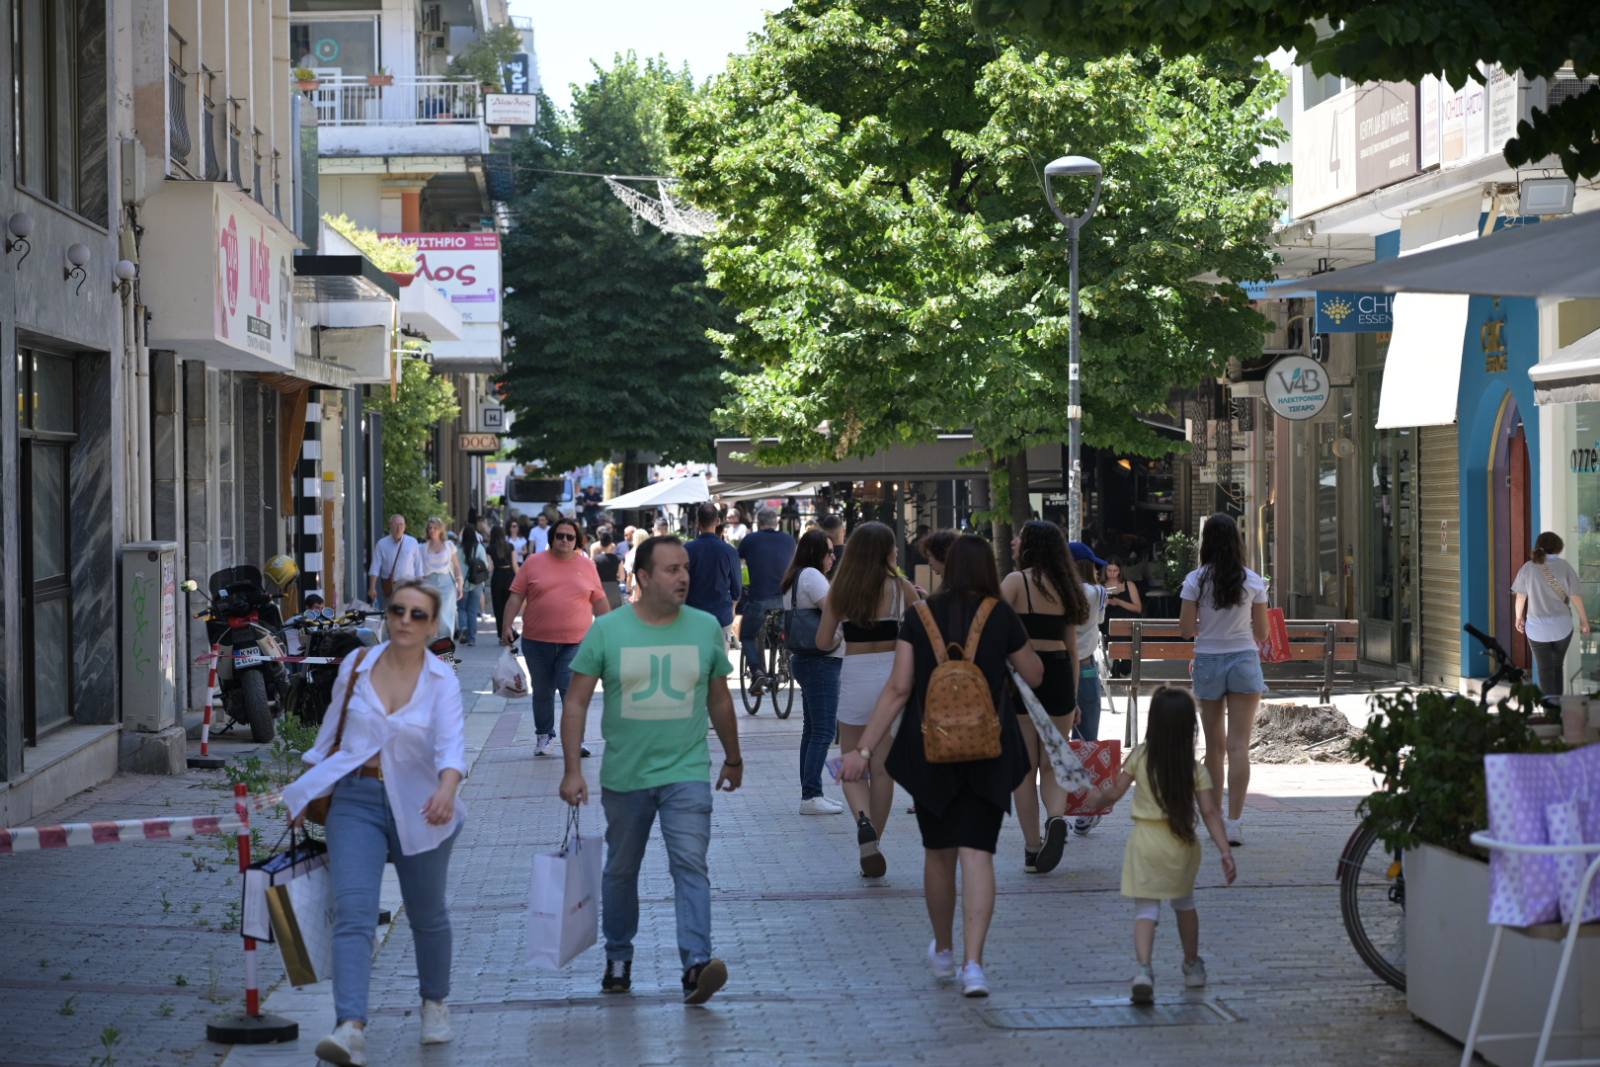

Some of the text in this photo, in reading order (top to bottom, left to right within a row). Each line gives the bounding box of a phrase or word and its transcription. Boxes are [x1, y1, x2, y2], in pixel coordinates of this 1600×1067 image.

[399, 236, 467, 249] ΝΤΙΣΤΗΡΙΟ
[416, 253, 477, 287] λος
[1358, 296, 1393, 313] CHI
[1358, 314, 1393, 325] ESSEN
[1276, 368, 1321, 394] V4B
[461, 436, 498, 449] DOCA
